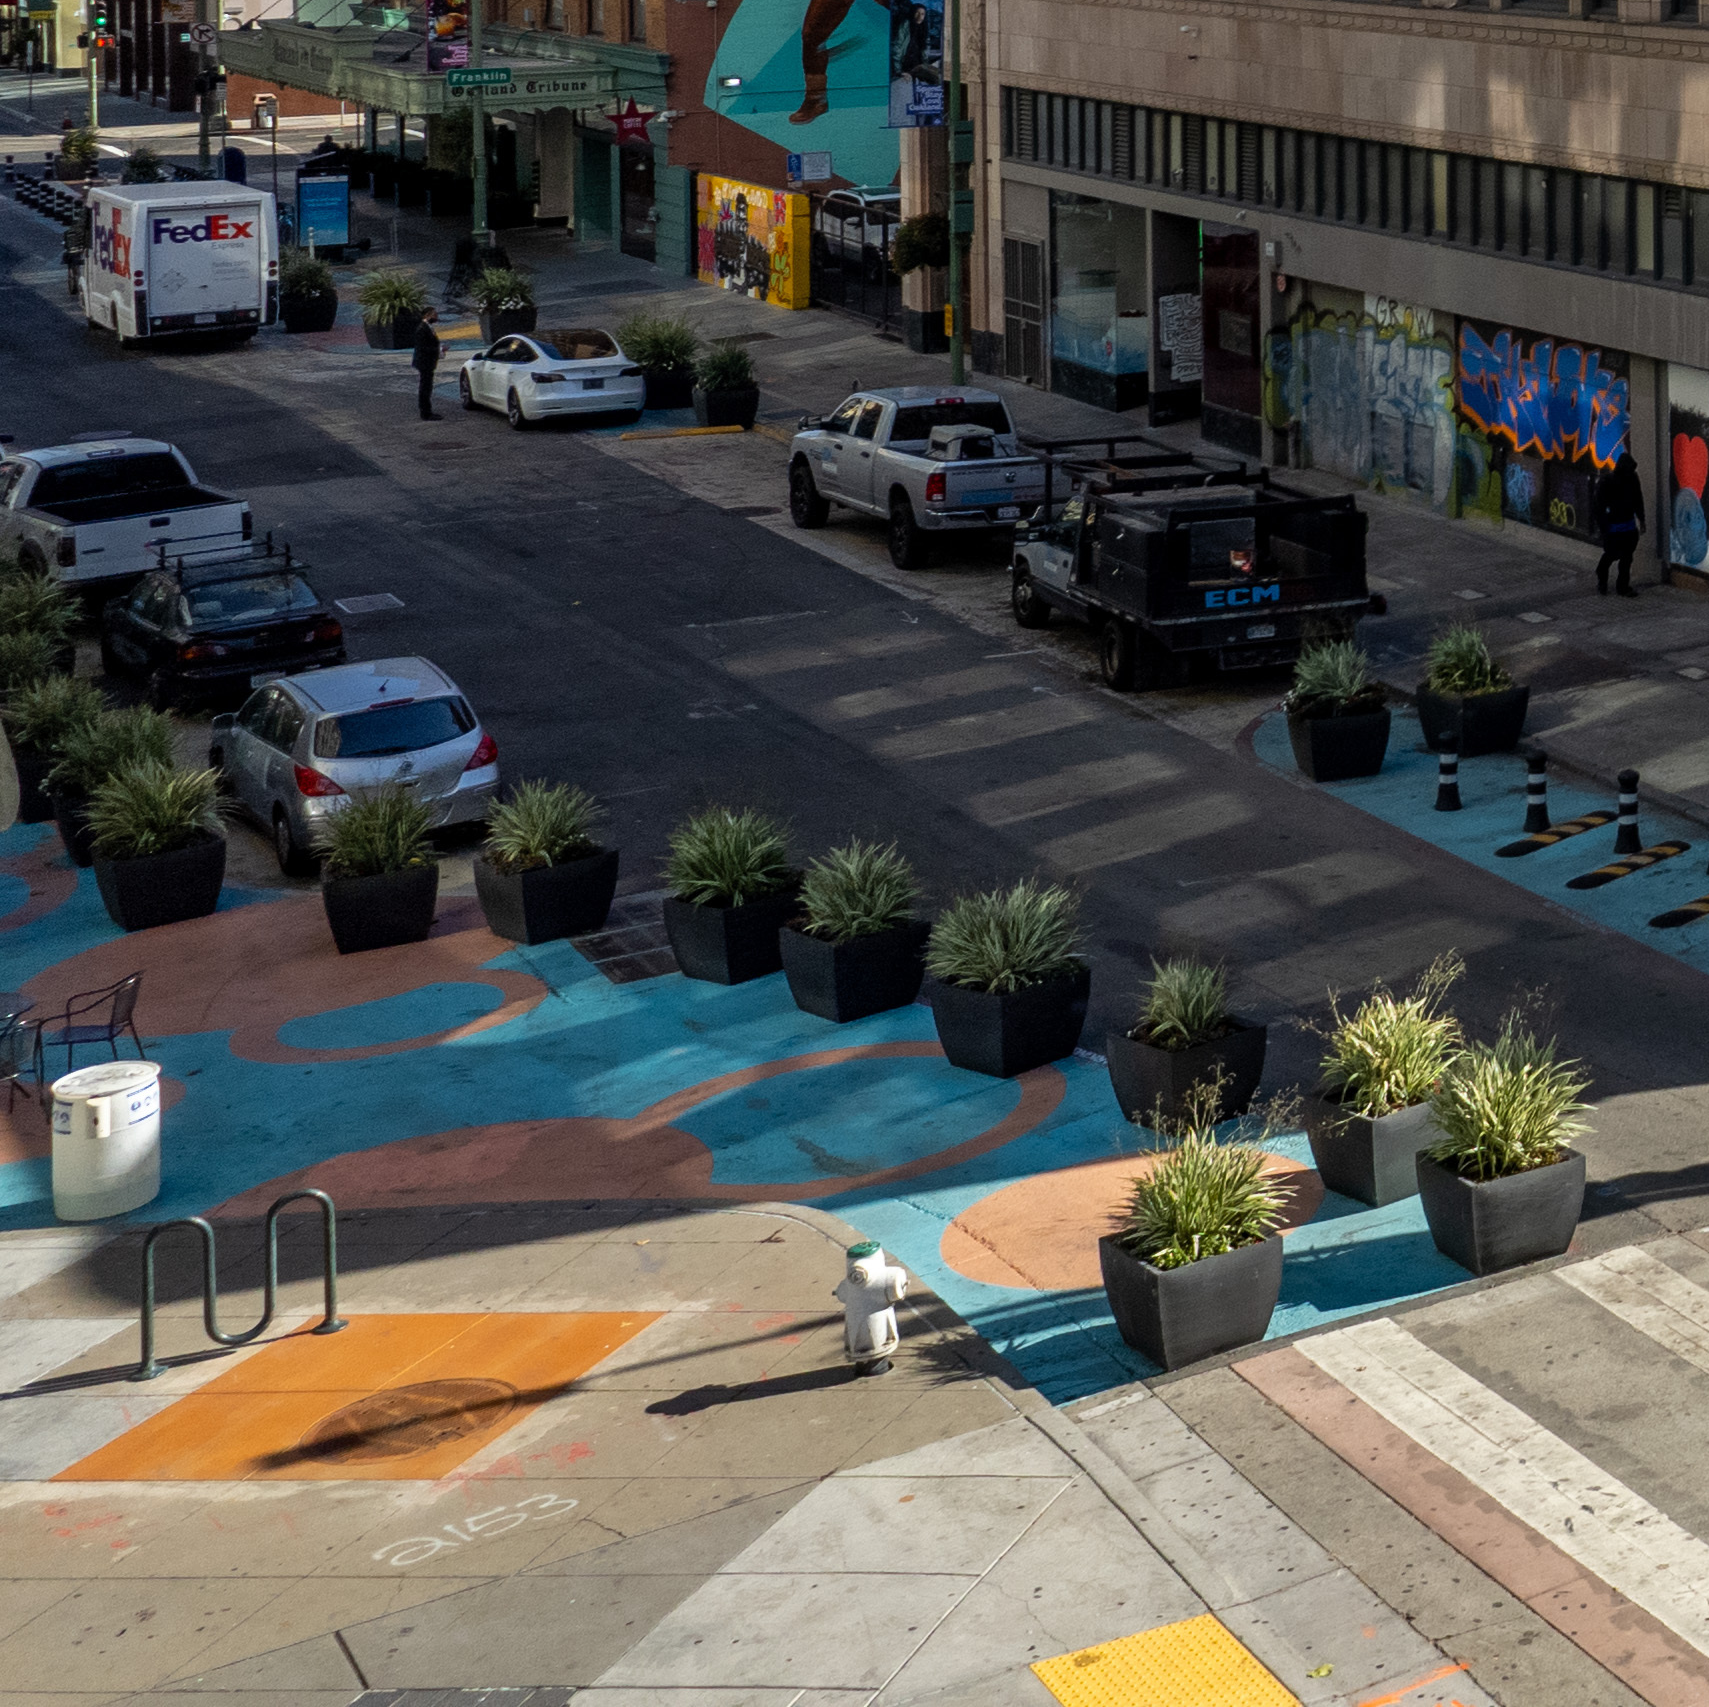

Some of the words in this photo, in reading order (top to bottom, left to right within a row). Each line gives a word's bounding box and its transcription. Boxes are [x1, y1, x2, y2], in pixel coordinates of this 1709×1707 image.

[452, 71, 507, 82] Franklin
[526, 80, 588, 93] Tribune
[153, 214, 254, 244] FedEx
[1376, 295, 1434, 339] GROW
[1205, 585, 1280, 608] ECM
[372, 1494, 579, 1565] 2153
